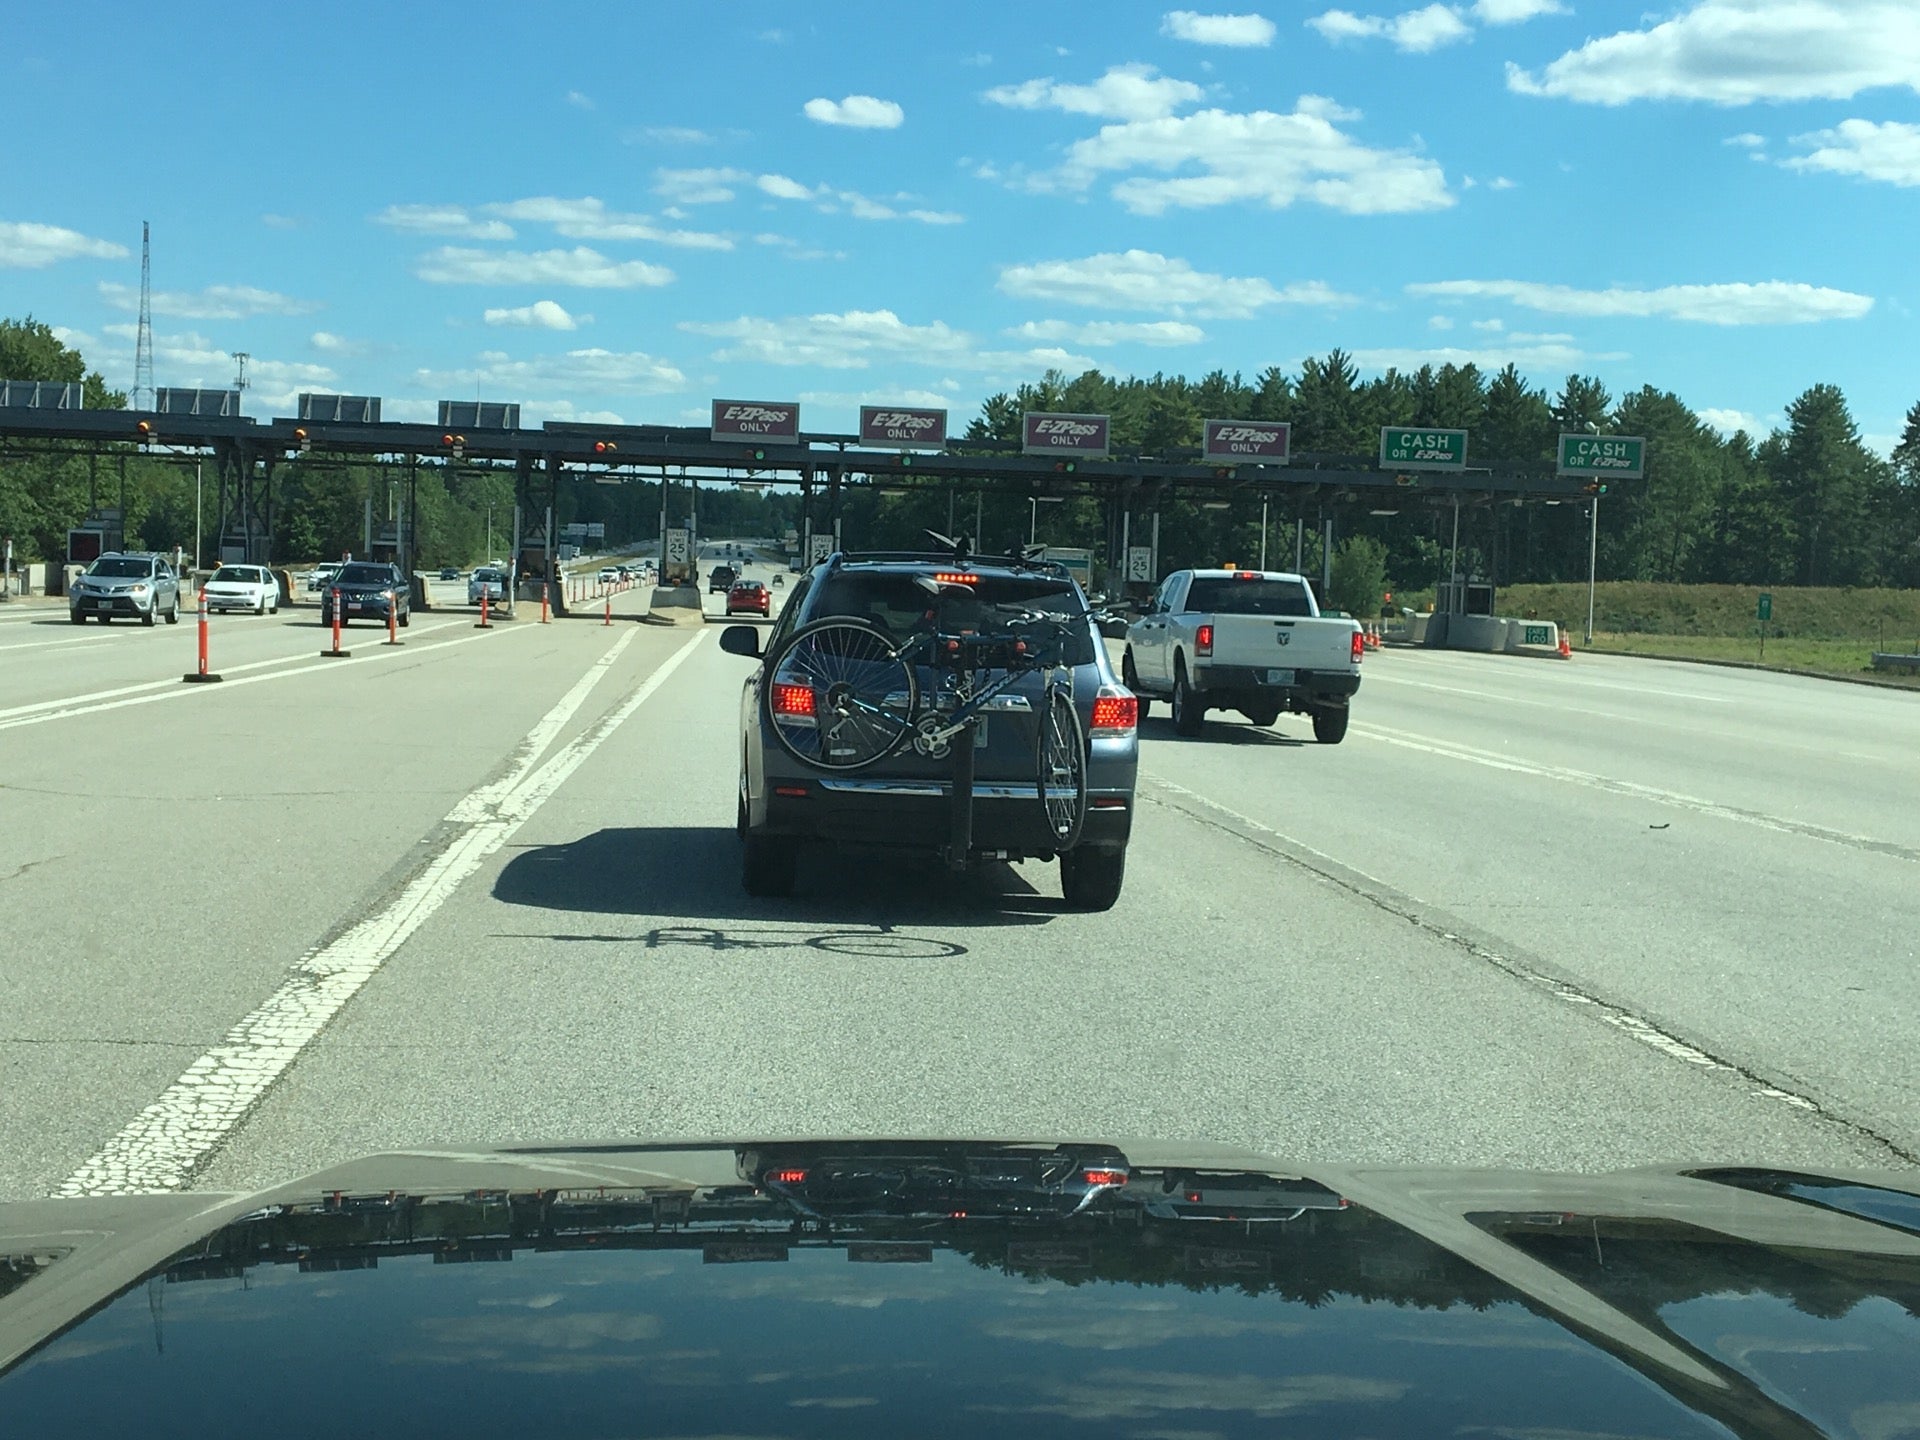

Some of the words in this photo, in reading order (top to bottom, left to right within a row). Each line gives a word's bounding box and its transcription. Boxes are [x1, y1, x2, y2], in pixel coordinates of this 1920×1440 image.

[740, 422, 771, 432] ONLY
[887, 429, 918, 439] ONLY
[1051, 436, 1080, 446] ONLY
[1401, 434, 1449, 449] CASH
[1231, 443, 1261, 453] ONLY
[1392, 448, 1408, 458] OR
[1578, 442, 1626, 457] CASH
[1569, 456, 1584, 466] OR
[670, 543, 685, 554] 25
[1132, 560, 1148, 571] 25
